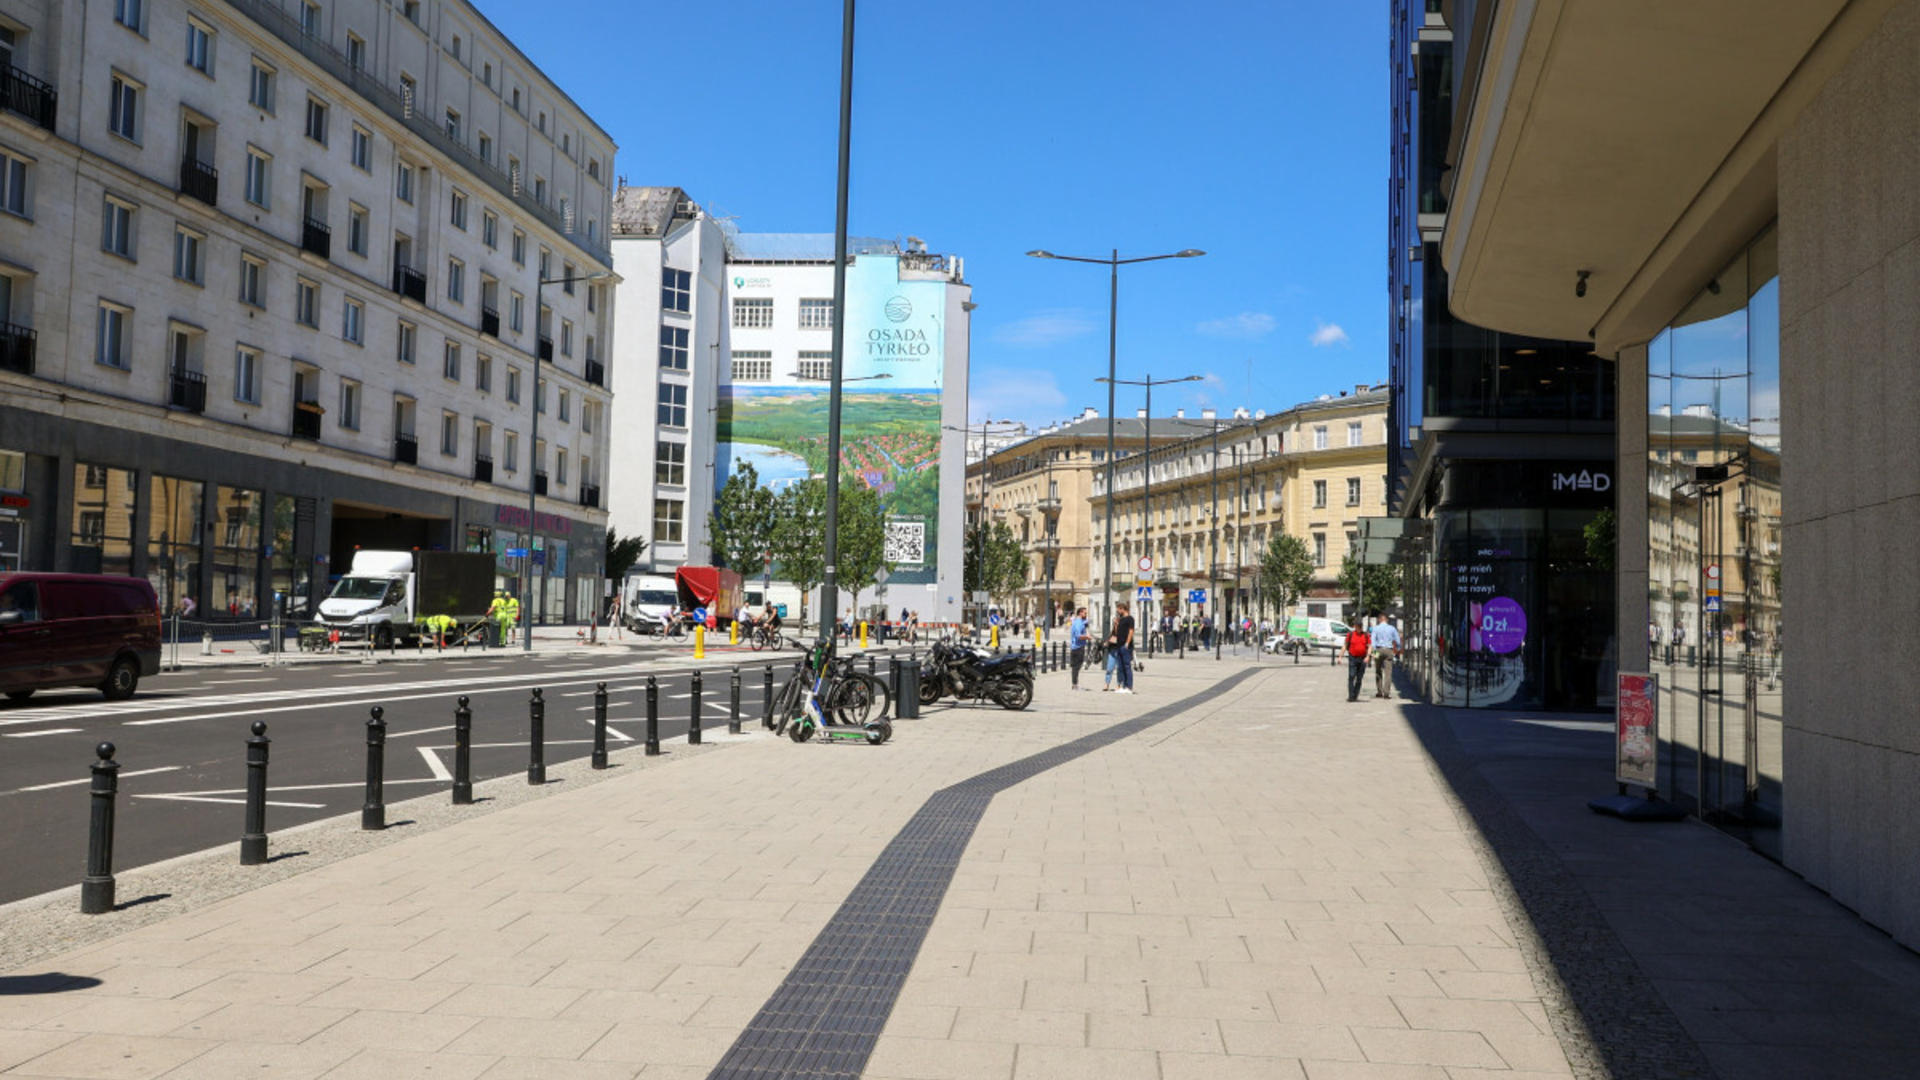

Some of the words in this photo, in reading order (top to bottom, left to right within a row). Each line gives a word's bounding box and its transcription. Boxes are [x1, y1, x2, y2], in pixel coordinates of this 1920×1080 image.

[868, 328, 926, 342] OSADA
[865, 341, 930, 355] TYRKŁO
[1552, 468, 1611, 491] iMAD
[1457, 563, 1492, 573] Wmień
[1482, 614, 1494, 631] 0
[1495, 617, 1508, 632] zł
